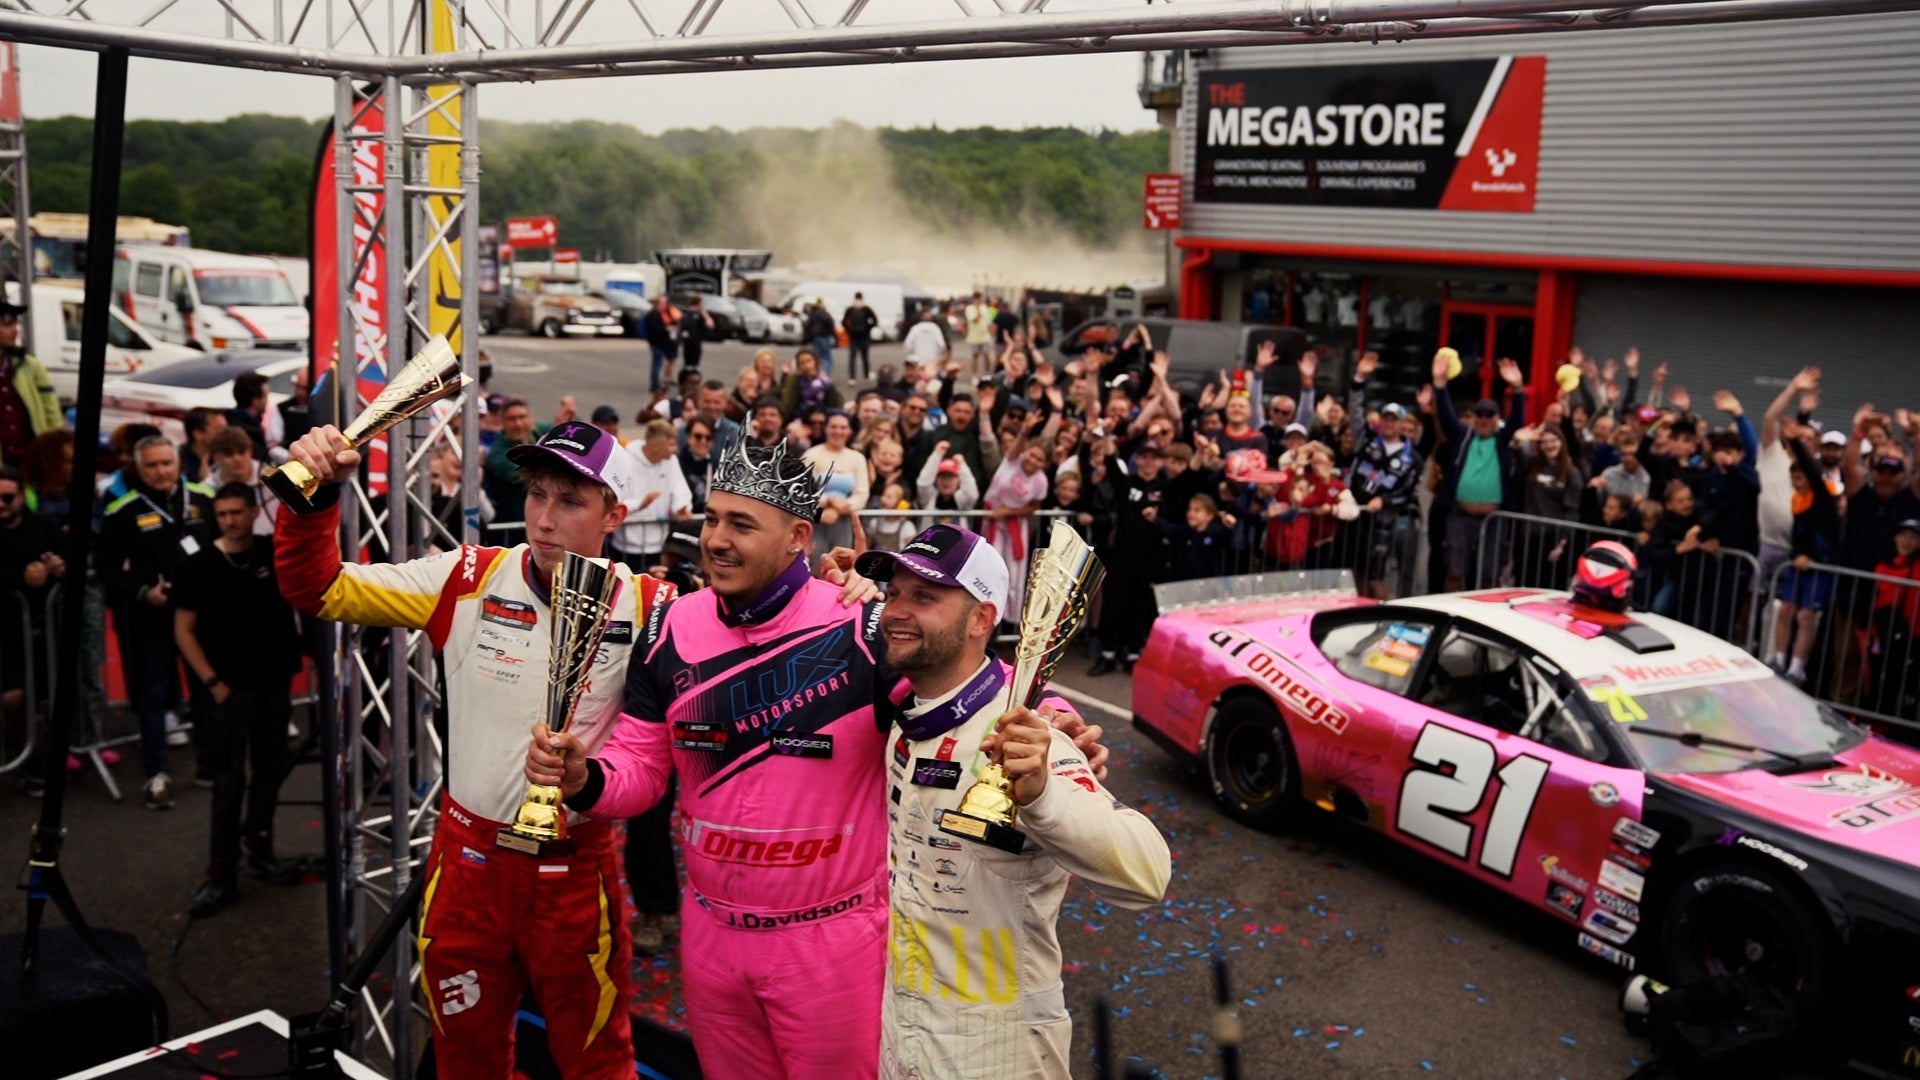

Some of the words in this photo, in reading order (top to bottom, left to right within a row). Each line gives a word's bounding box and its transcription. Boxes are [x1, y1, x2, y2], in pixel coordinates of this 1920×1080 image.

[1209, 83, 1245, 106] THE
[1207, 103, 1446, 146] MEGASTORE
[1611, 655, 1728, 681] WHELEN
[735, 671, 850, 734] MOTORSPORT
[964, 673, 996, 706] HOOSIER
[1247, 652, 1349, 728] Omega
[772, 737, 831, 750] HOOSIER
[916, 767, 958, 777] HOOSIER
[1396, 721, 1551, 880] 21
[726, 893, 863, 929] J.Davidson
